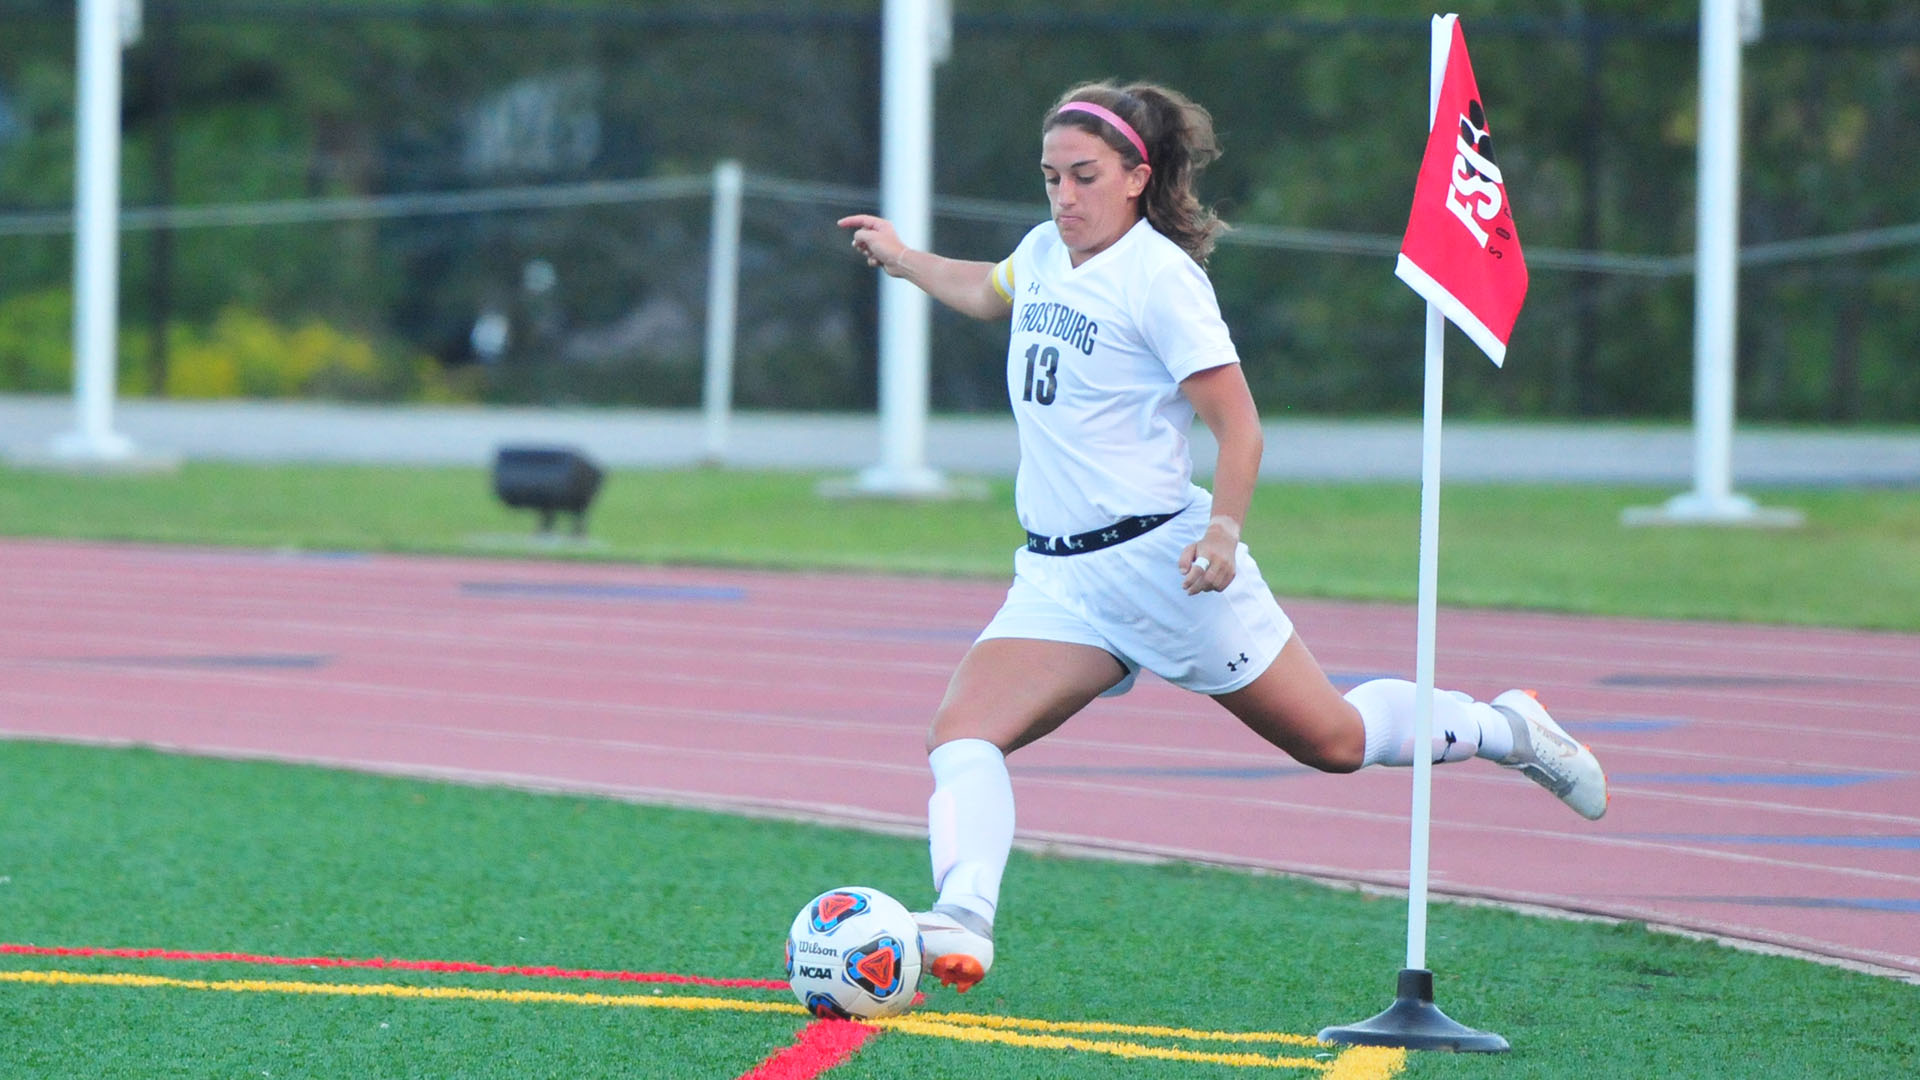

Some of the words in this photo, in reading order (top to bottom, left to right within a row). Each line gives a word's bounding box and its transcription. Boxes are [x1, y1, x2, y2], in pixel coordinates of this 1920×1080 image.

[1022, 343, 1060, 406] 13
[798, 941, 837, 957] Wilson
[799, 965, 832, 979] NCAA
